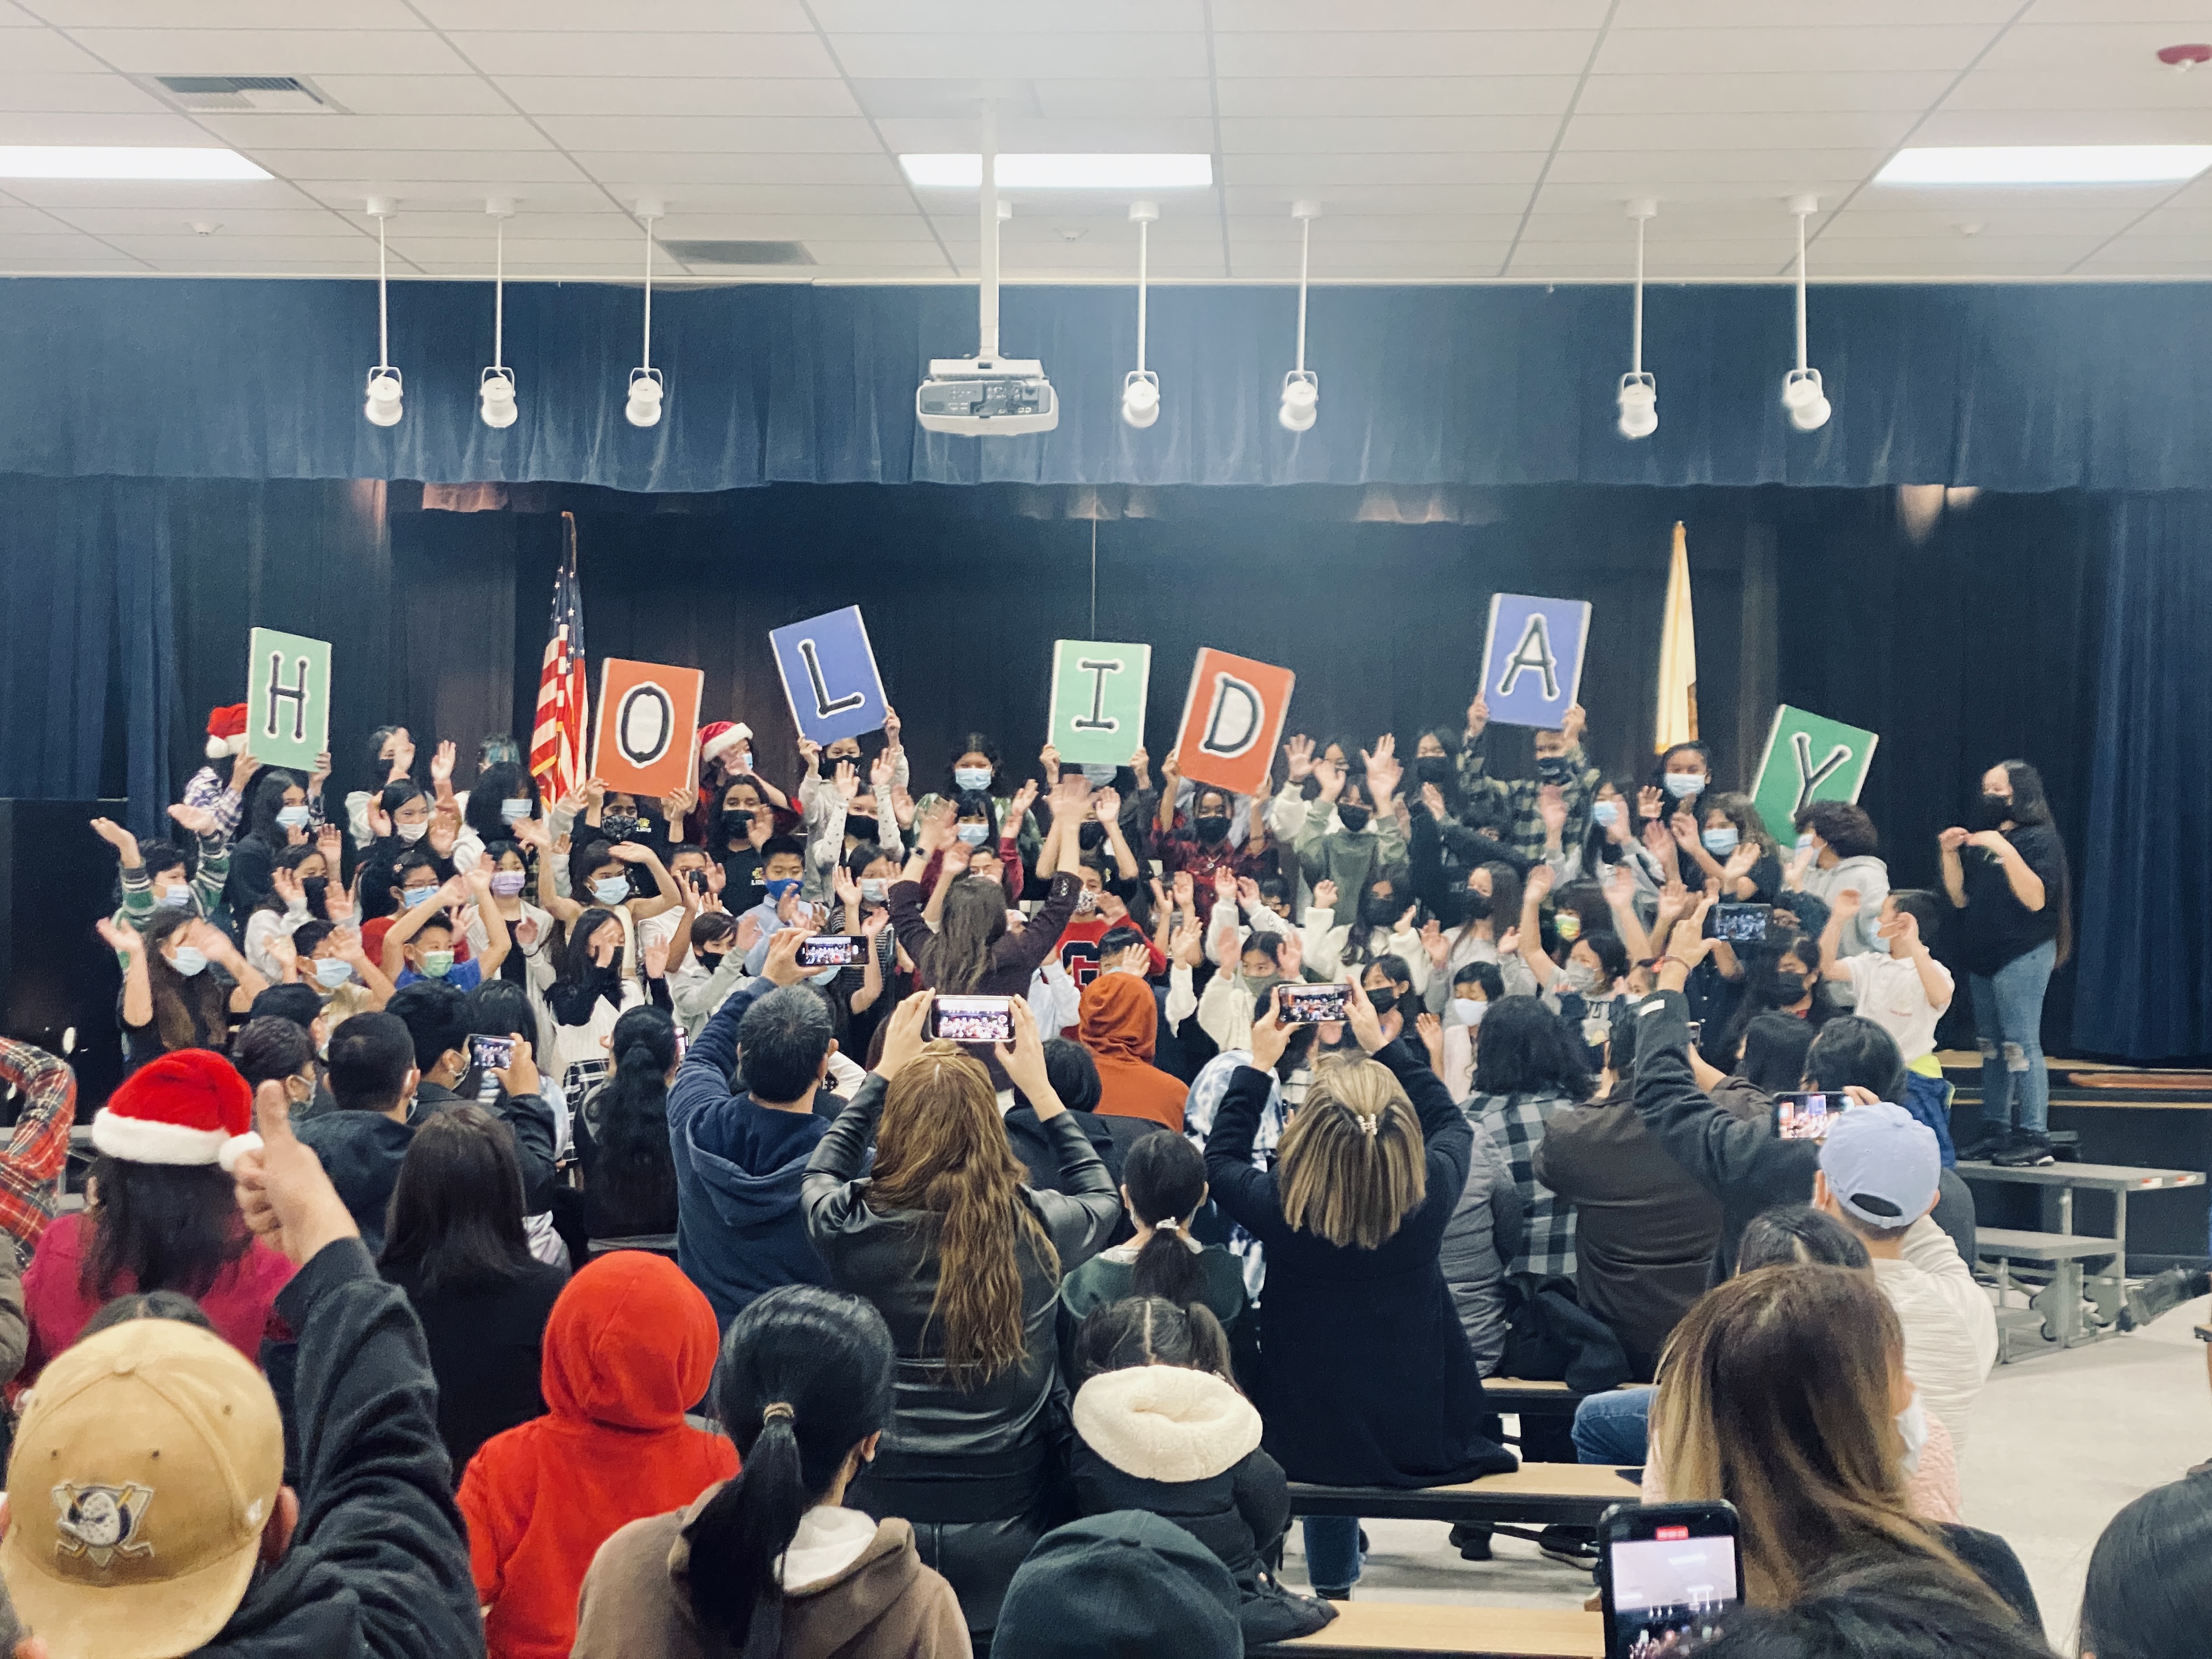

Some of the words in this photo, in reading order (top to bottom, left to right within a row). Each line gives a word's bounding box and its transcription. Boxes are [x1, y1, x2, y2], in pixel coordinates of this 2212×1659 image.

[263, 650, 309, 743] H
[798, 639, 866, 718] L
[1071, 657, 1125, 733] I
[1496, 613, 1561, 702] A
[616, 680, 675, 769] O
[1198, 671, 1264, 759] D
[1788, 731, 1852, 822] Y
